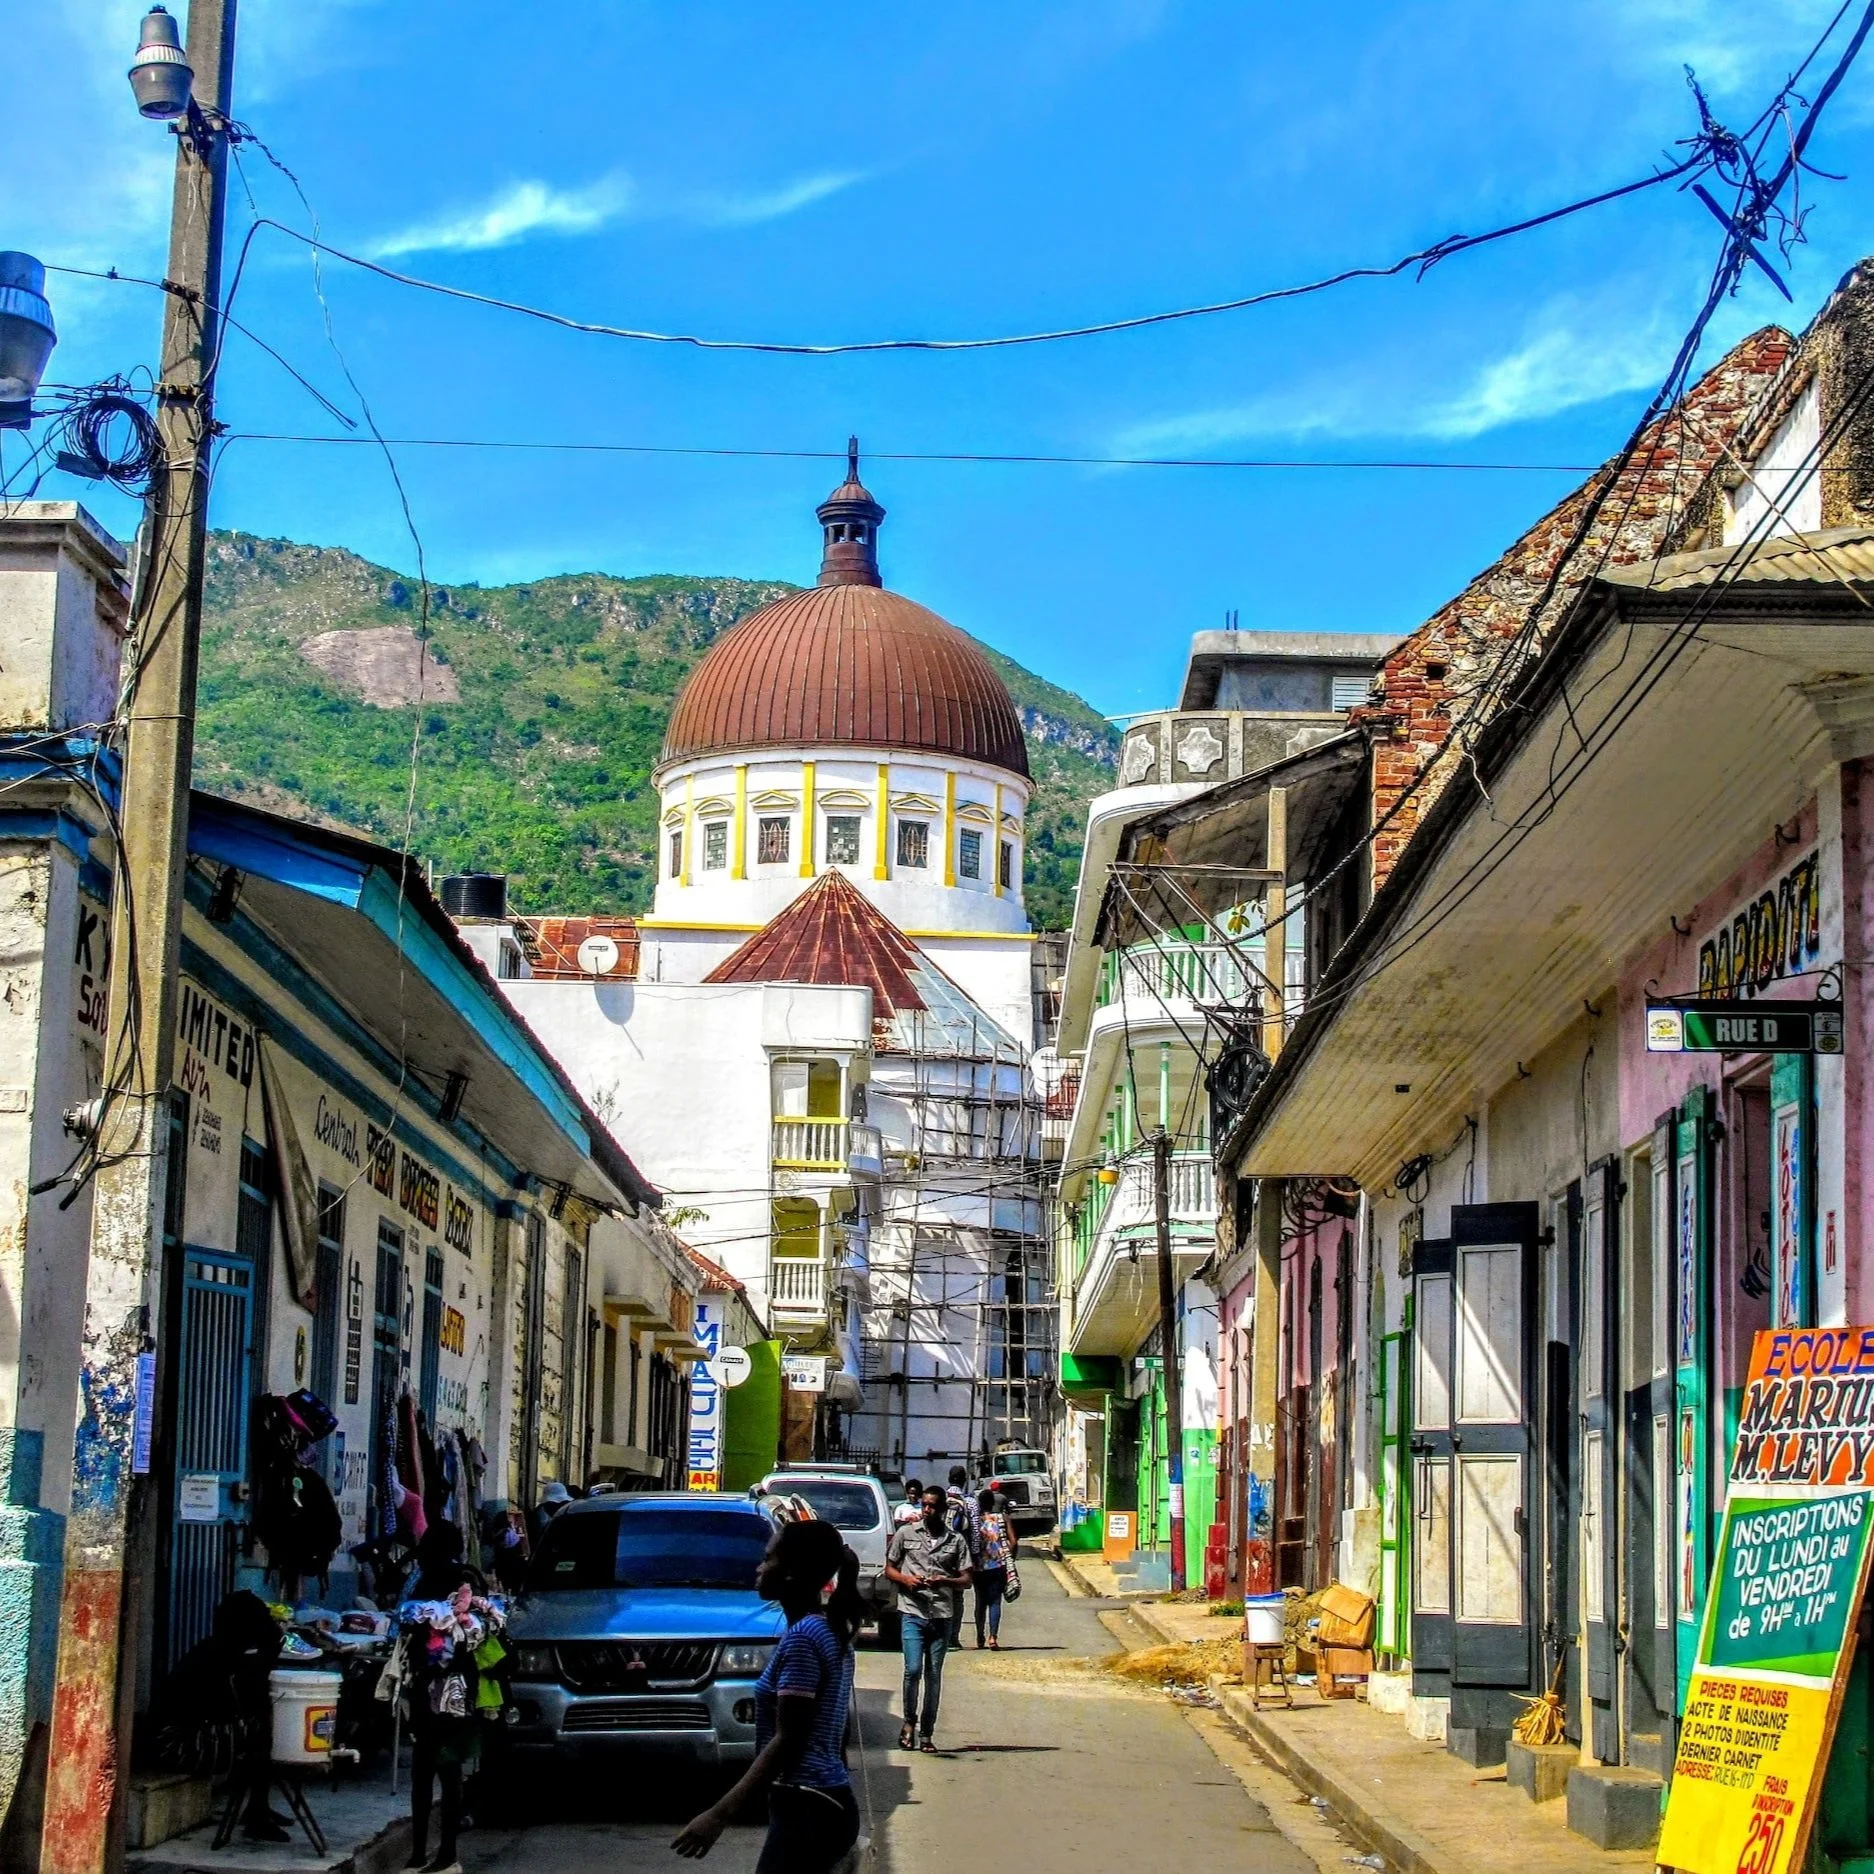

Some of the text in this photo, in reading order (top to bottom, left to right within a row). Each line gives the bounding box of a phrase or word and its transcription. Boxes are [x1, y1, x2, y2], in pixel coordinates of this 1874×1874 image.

[180, 985, 256, 1088] IMITED
[1716, 1018, 1778, 1042] RUE D
[1764, 1331, 1874, 1376] ECOLE
[1741, 1378, 1874, 1433] MARIU
[1732, 1495, 1864, 1548] INSCRIPTIONS
[1734, 1534, 1850, 1578] DU LUNDI au
[1740, 1562, 1832, 1606] VENDREDI
[1728, 1610, 1750, 1639] de
[1700, 1681, 1789, 1708] PIECES REQUISES
[1694, 1723, 1733, 1743] PHOTOS
[1719, 1704, 1732, 1721] DE
[1736, 1707, 1789, 1730] NAISSANCE
[1723, 1749, 1762, 1770] CARNET
[1736, 1813, 1785, 1874] 250
